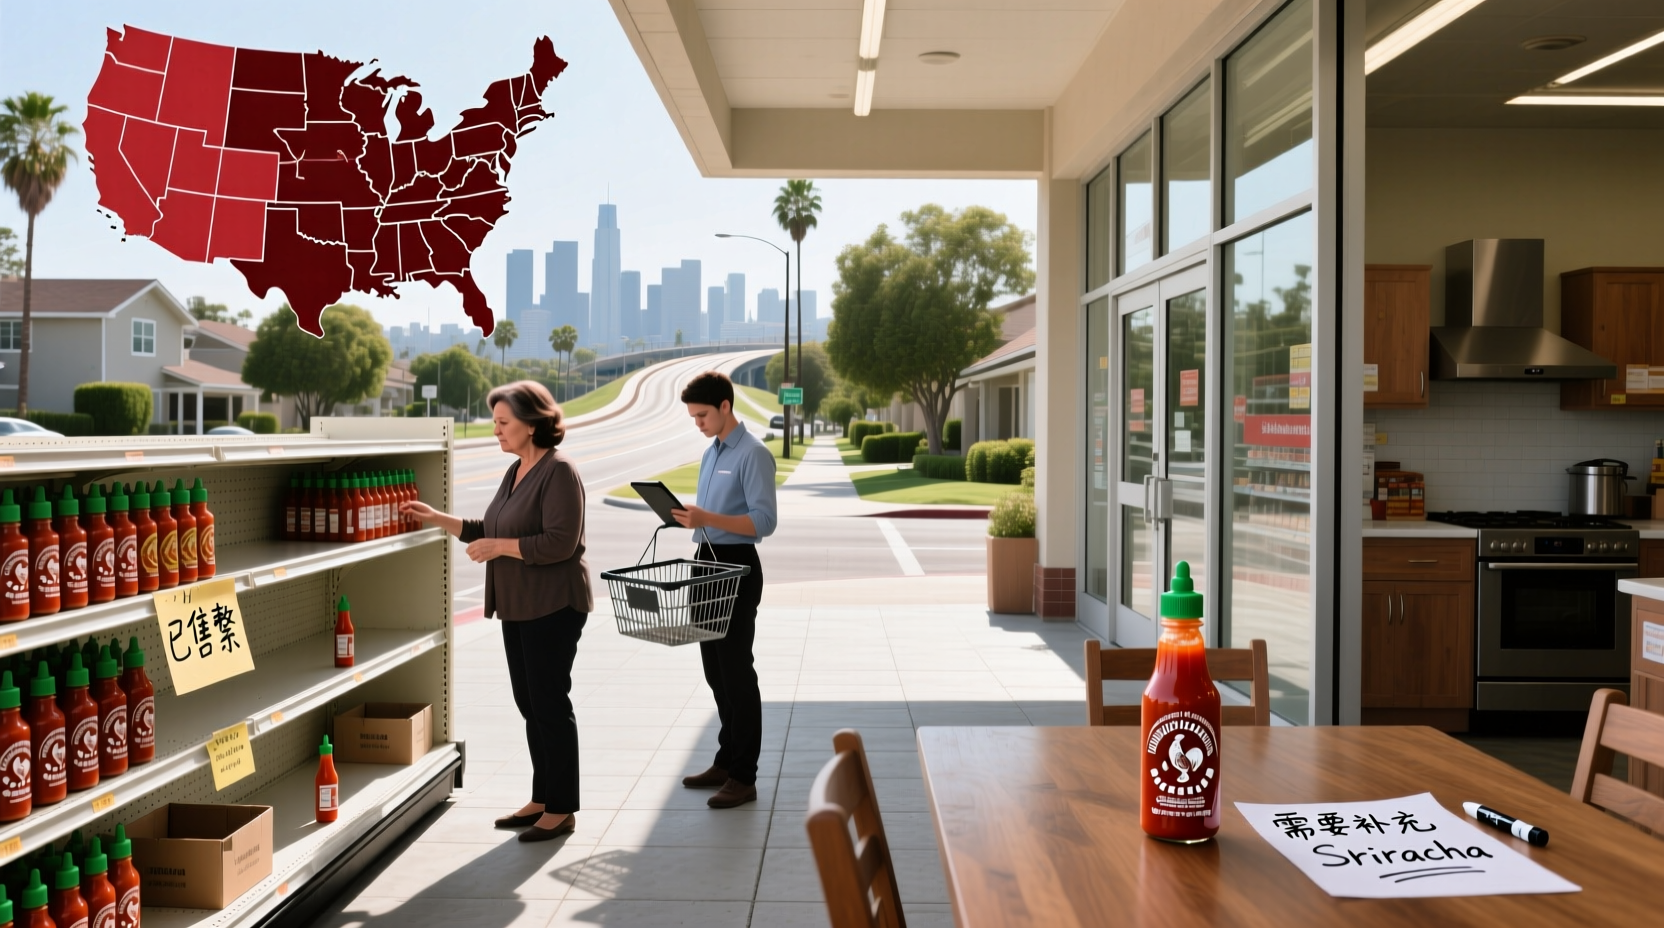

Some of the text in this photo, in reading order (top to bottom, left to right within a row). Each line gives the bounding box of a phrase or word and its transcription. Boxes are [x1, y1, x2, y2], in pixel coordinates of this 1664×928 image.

[1272, 811, 1437, 841] 需要补充
[1312, 840, 1494, 867] Sriracha
